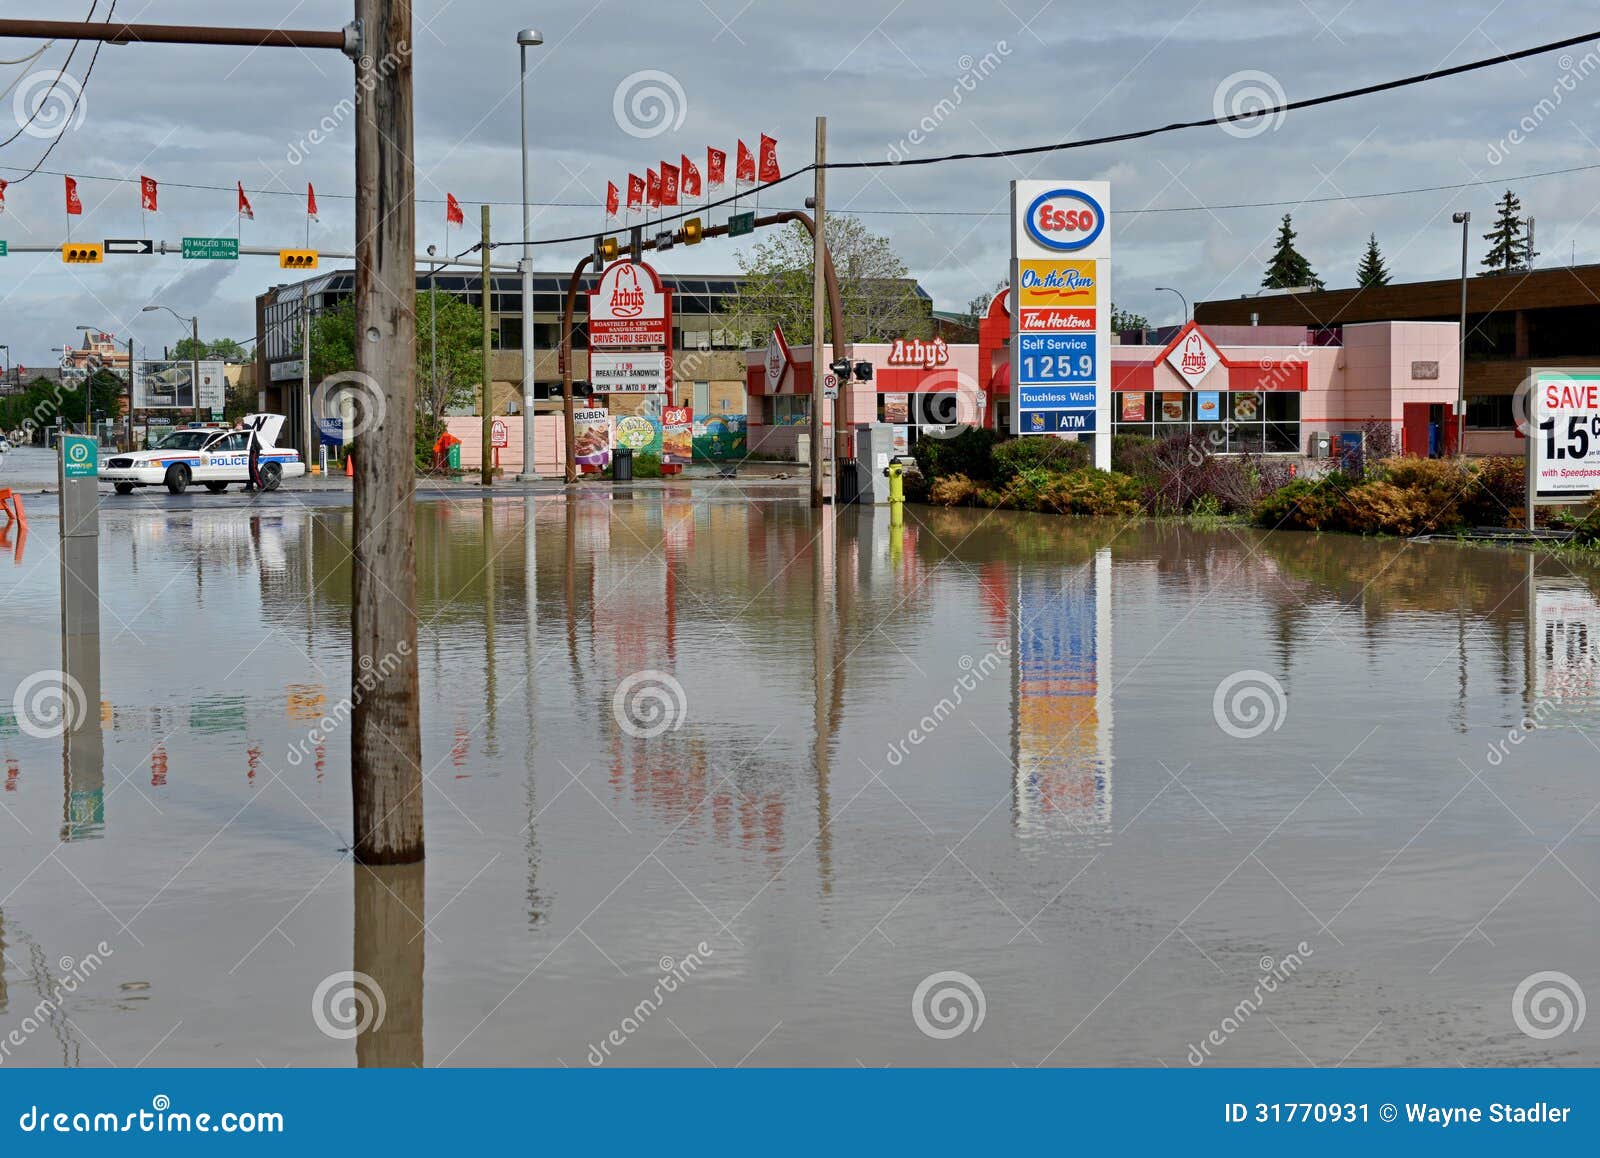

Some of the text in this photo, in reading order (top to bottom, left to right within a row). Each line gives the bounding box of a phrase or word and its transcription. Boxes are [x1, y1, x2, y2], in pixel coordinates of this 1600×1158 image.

[221, 240, 236, 248] TRAIL
[1021, 269, 1094, 289] On the Run
[610, 286, 645, 310] Arby's
[1024, 311, 1090, 328] Tim Hortons
[593, 333, 663, 343] DRIVE-THRU SERVICE
[1022, 339, 1087, 350] Self Service
[889, 336, 949, 370] Arby's
[1182, 351, 1206, 369] Arby's
[1024, 355, 1093, 378] 125.9
[629, 369, 660, 377] SANDWICH
[596, 383, 611, 391] OPEN
[1022, 392, 1095, 402] Touchless Wash
[1546, 385, 1599, 409] SAVE
[574, 411, 605, 420] REUBEN
[1060, 415, 1085, 427] ATM
[210, 457, 248, 466] POLICE
[1541, 468, 1600, 479] with Speedpass
